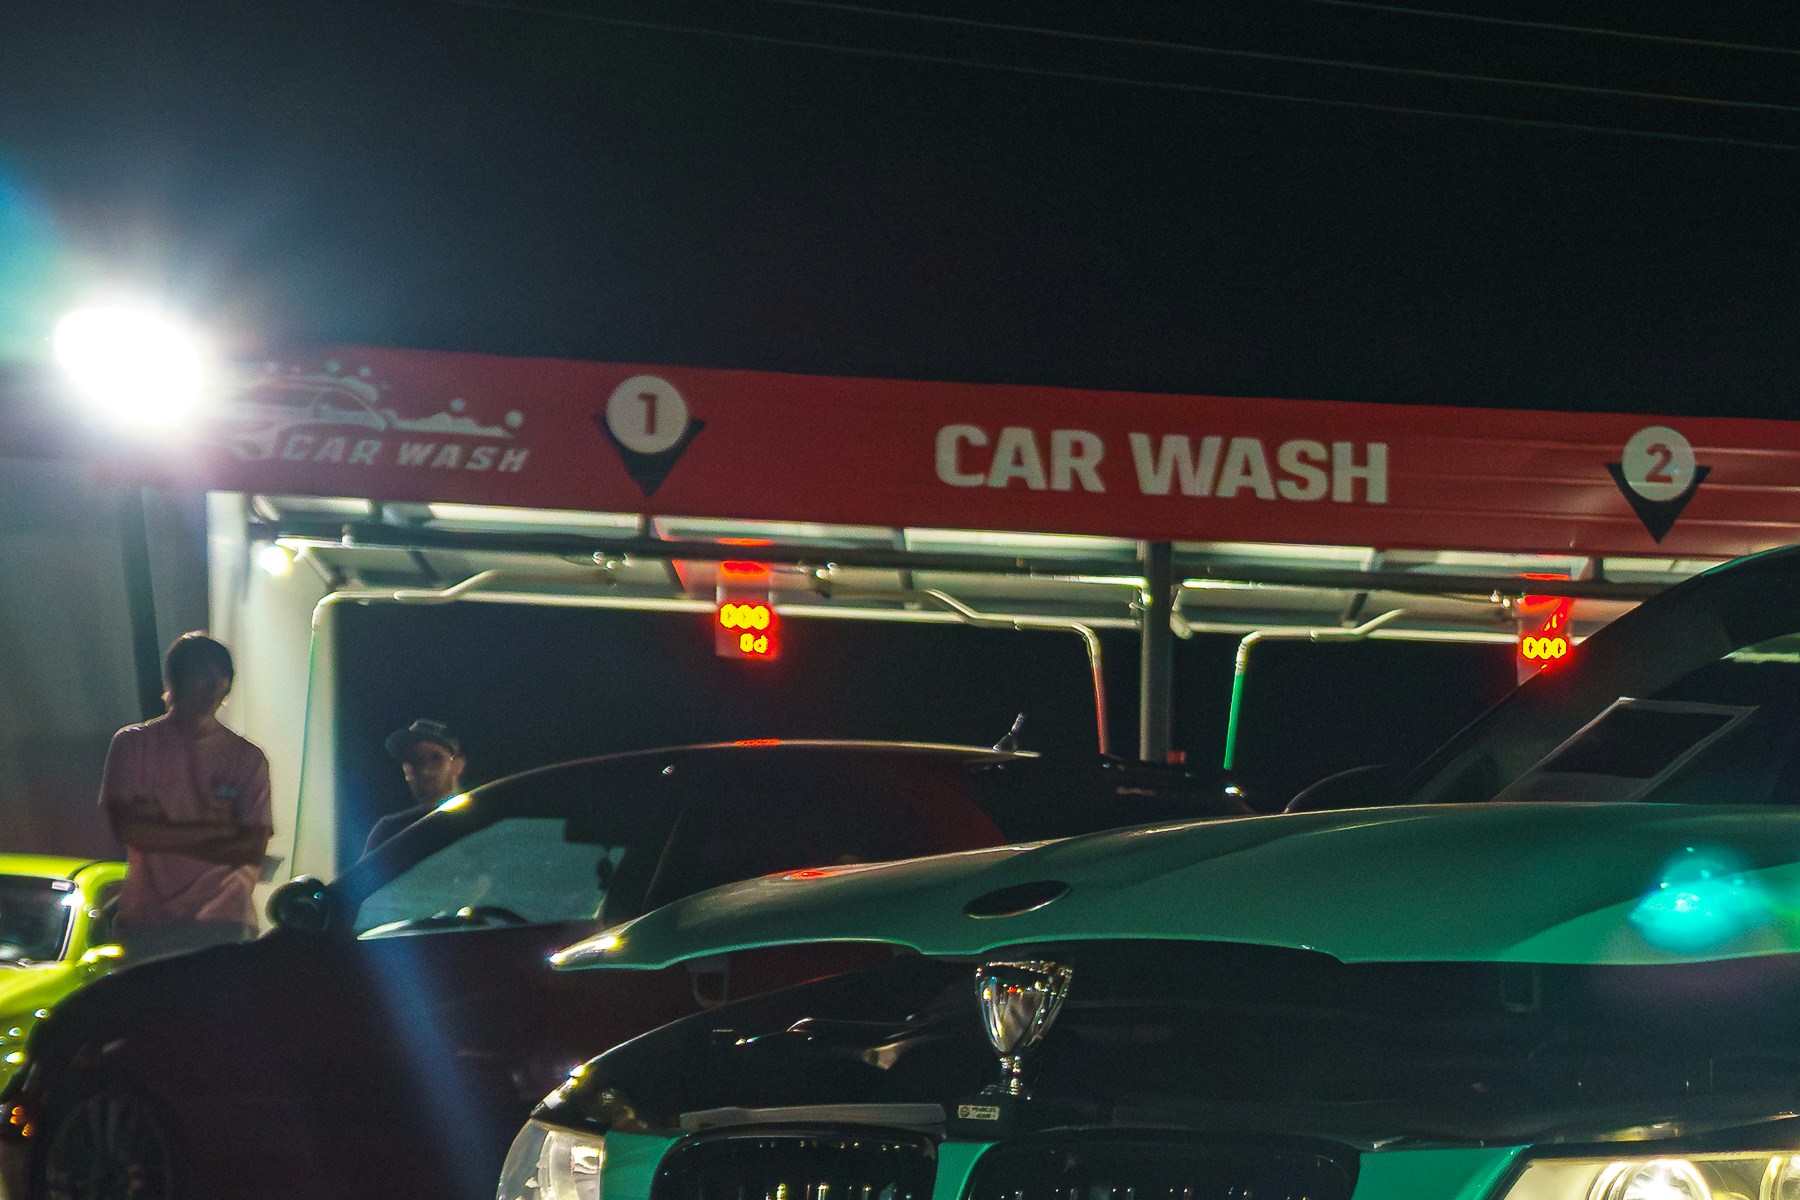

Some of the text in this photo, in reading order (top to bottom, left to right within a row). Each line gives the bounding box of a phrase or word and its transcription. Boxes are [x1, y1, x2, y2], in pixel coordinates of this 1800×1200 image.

[638, 392, 658, 436] 1
[279, 434, 530, 473] CAR WASH
[934, 424, 1389, 504] CAR WASH
[1645, 443, 1673, 484] 2
